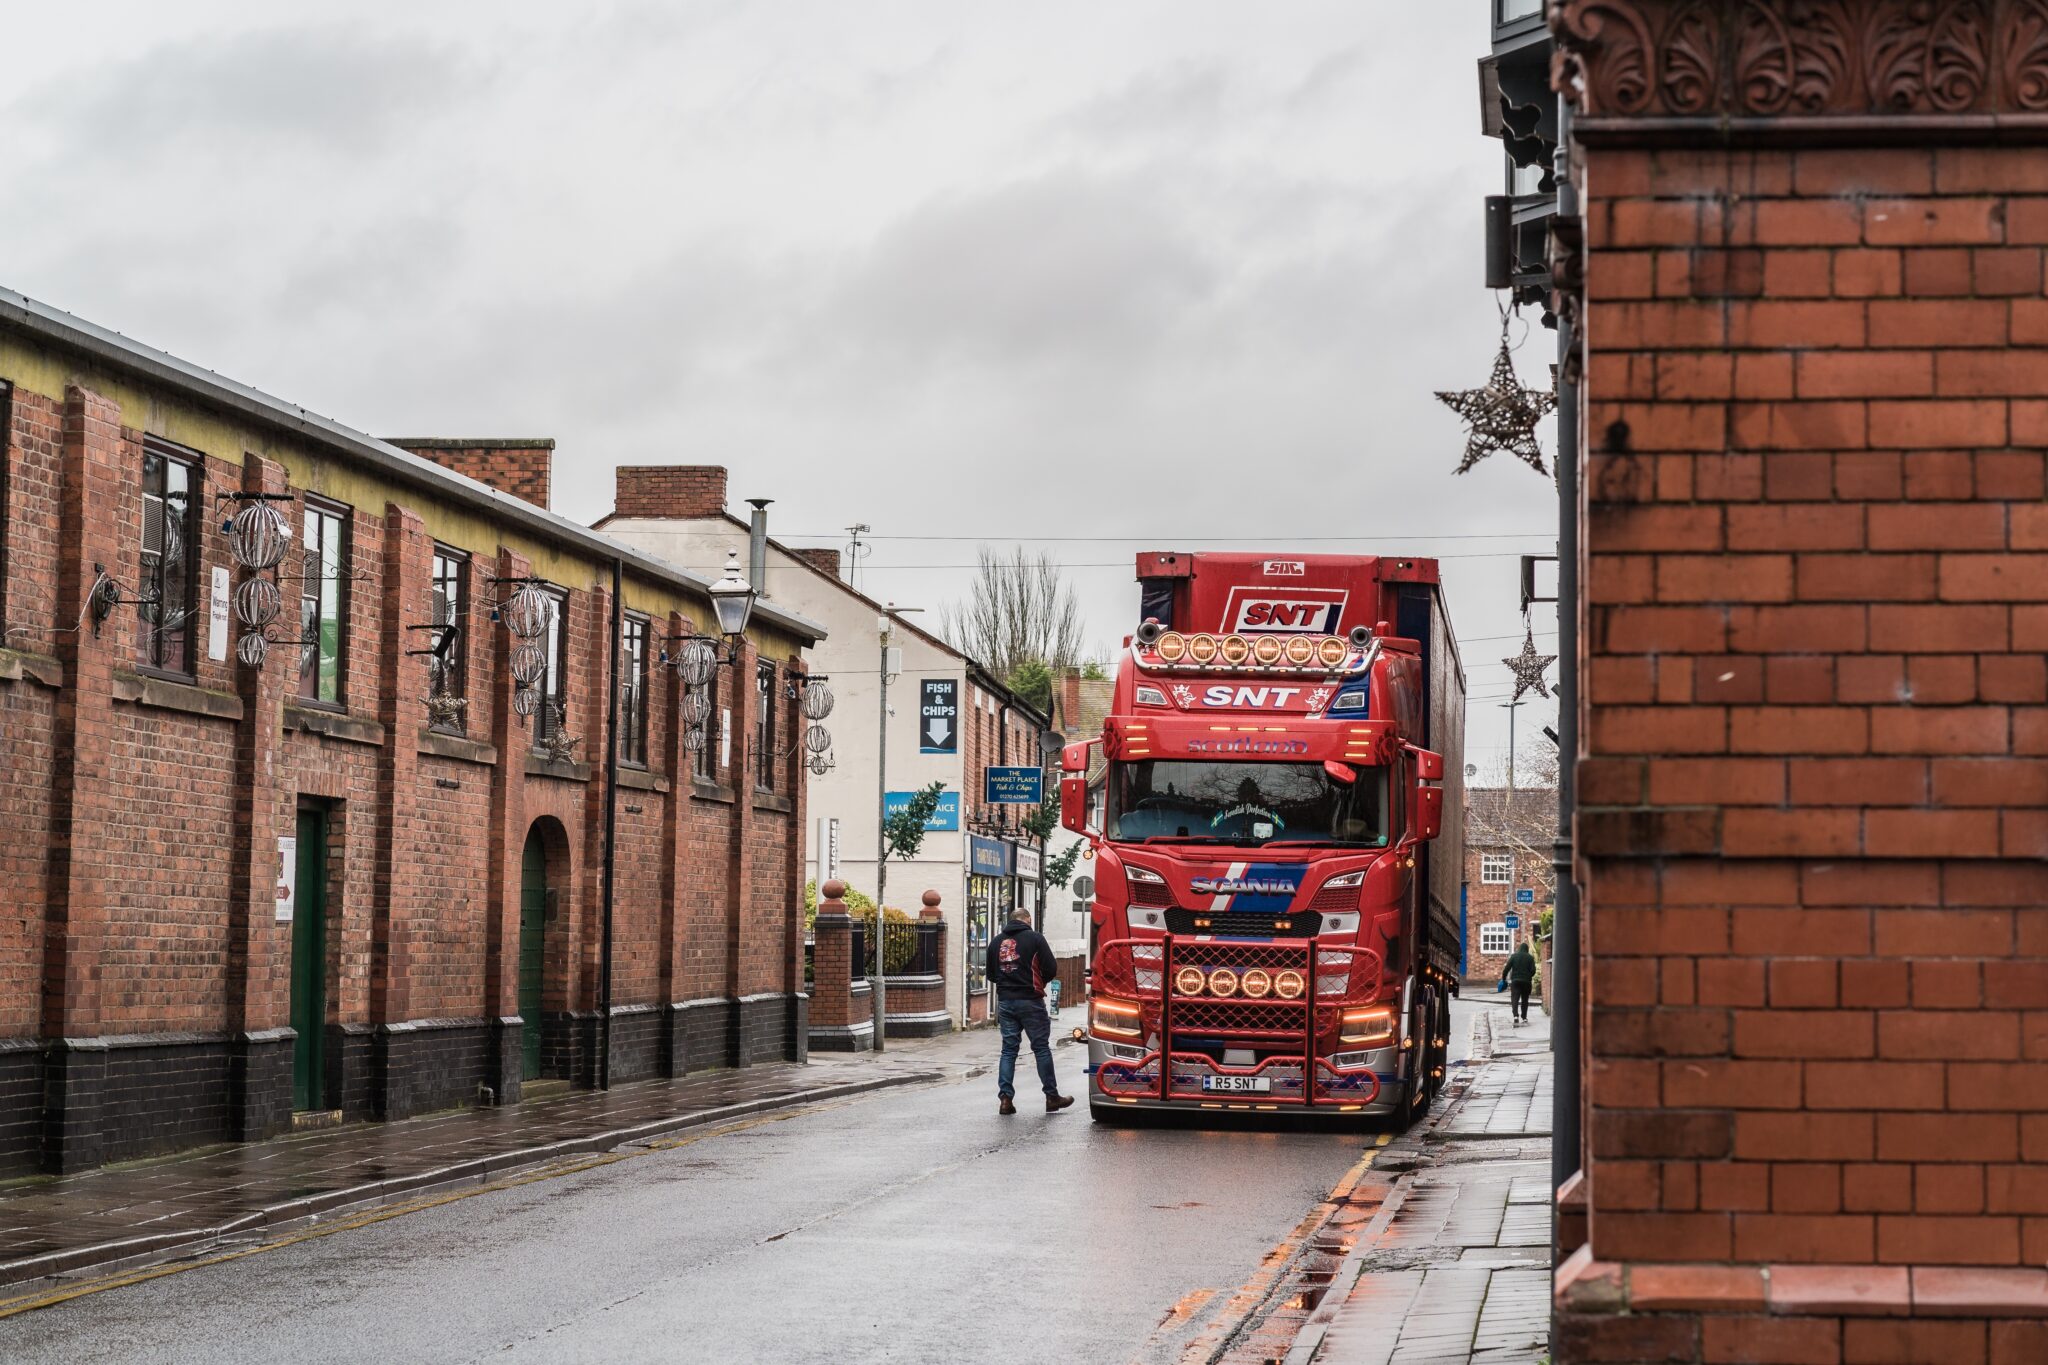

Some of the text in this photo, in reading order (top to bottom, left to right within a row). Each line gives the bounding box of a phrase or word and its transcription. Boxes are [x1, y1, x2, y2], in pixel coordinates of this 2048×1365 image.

[1244, 602, 1325, 626] SNT
[926, 683, 952, 693] FISH
[934, 694, 944, 705] &
[1202, 686, 1300, 708] SNT
[922, 705, 956, 716] CHIPS
[996, 783, 1008, 791] Fish
[1015, 783, 1033, 792] Chips
[1190, 876, 1297, 897] SCANIA
[1215, 1077, 1258, 1090] R5 SNT
